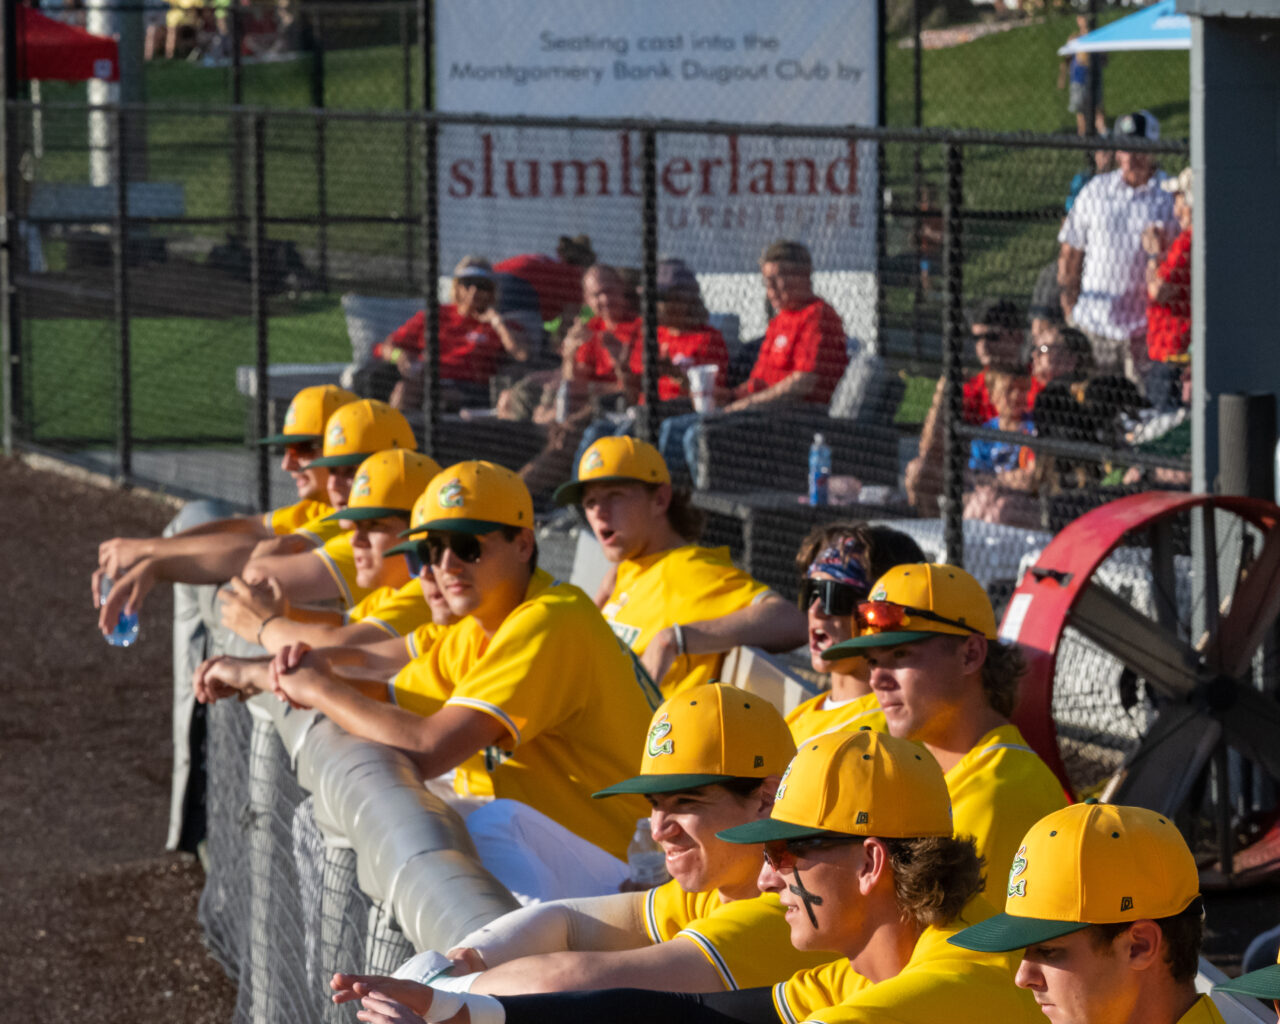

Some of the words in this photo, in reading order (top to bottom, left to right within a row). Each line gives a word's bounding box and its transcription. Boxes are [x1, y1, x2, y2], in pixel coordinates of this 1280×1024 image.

[538, 30, 629, 56] Seating
[637, 34, 684, 51] cast
[691, 32, 737, 51] into
[744, 32, 780, 51] the
[450, 60, 604, 86] Montgomery
[613, 59, 671, 80] Bank
[681, 59, 768, 85] Dugout
[775, 59, 830, 80] Club
[837, 60, 863, 84] by
[665, 202, 864, 231] URNITURE
